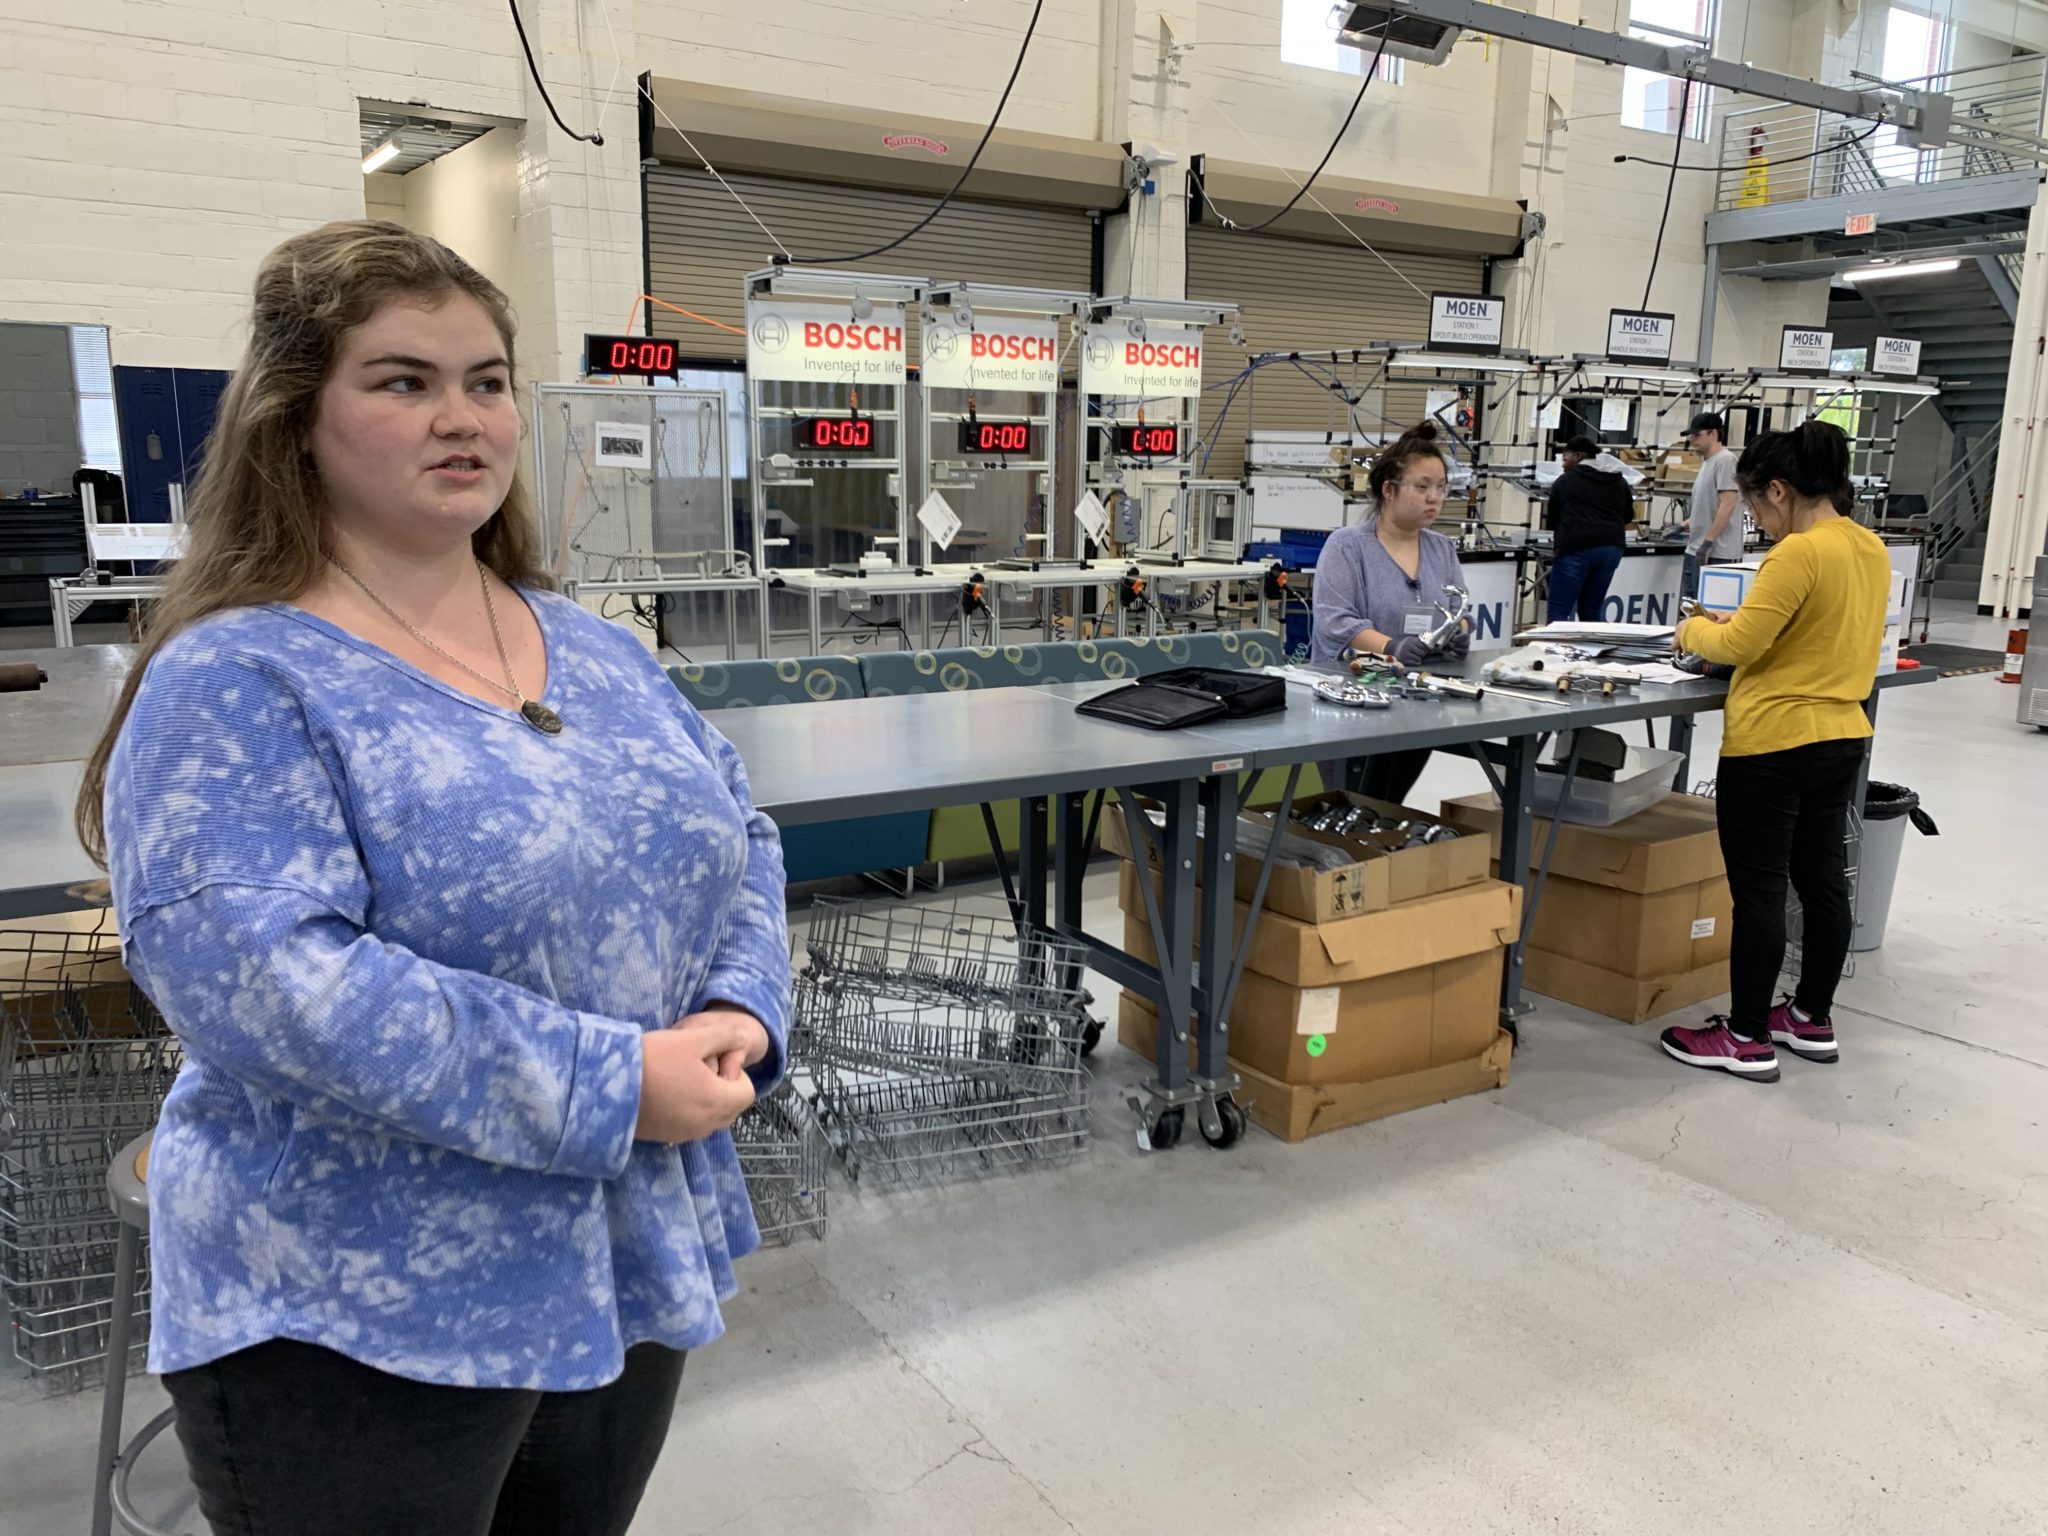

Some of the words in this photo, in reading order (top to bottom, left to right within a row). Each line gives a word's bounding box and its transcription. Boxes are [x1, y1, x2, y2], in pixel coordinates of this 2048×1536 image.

[1850, 215, 1871, 233] EXIT
[1446, 300, 1488, 317] MOEN
[1453, 321, 1475, 330] STATION
[1623, 317, 1660, 333] MOEN
[804, 322, 902, 352] BOSCH
[1468, 333, 1498, 342] OPERATION
[1792, 332, 1823, 346] MOEN
[971, 333, 1054, 361] BOSCH
[1884, 339, 1912, 353] MOEN
[611, 342, 672, 370] 0:00
[1125, 342, 1199, 368] BOSCH
[804, 357, 861, 372] Invented
[864, 360, 881, 373] for
[885, 360, 903, 374] life
[1021, 368, 1036, 381] for
[1039, 369, 1055, 382] life
[1124, 373, 1167, 386] Invented
[1169, 375, 1182, 387] for
[1184, 375, 1199, 388] life
[816, 420, 869, 446] 0:00
[981, 425, 1026, 449] 0:00
[1600, 592, 1670, 626] OEN
